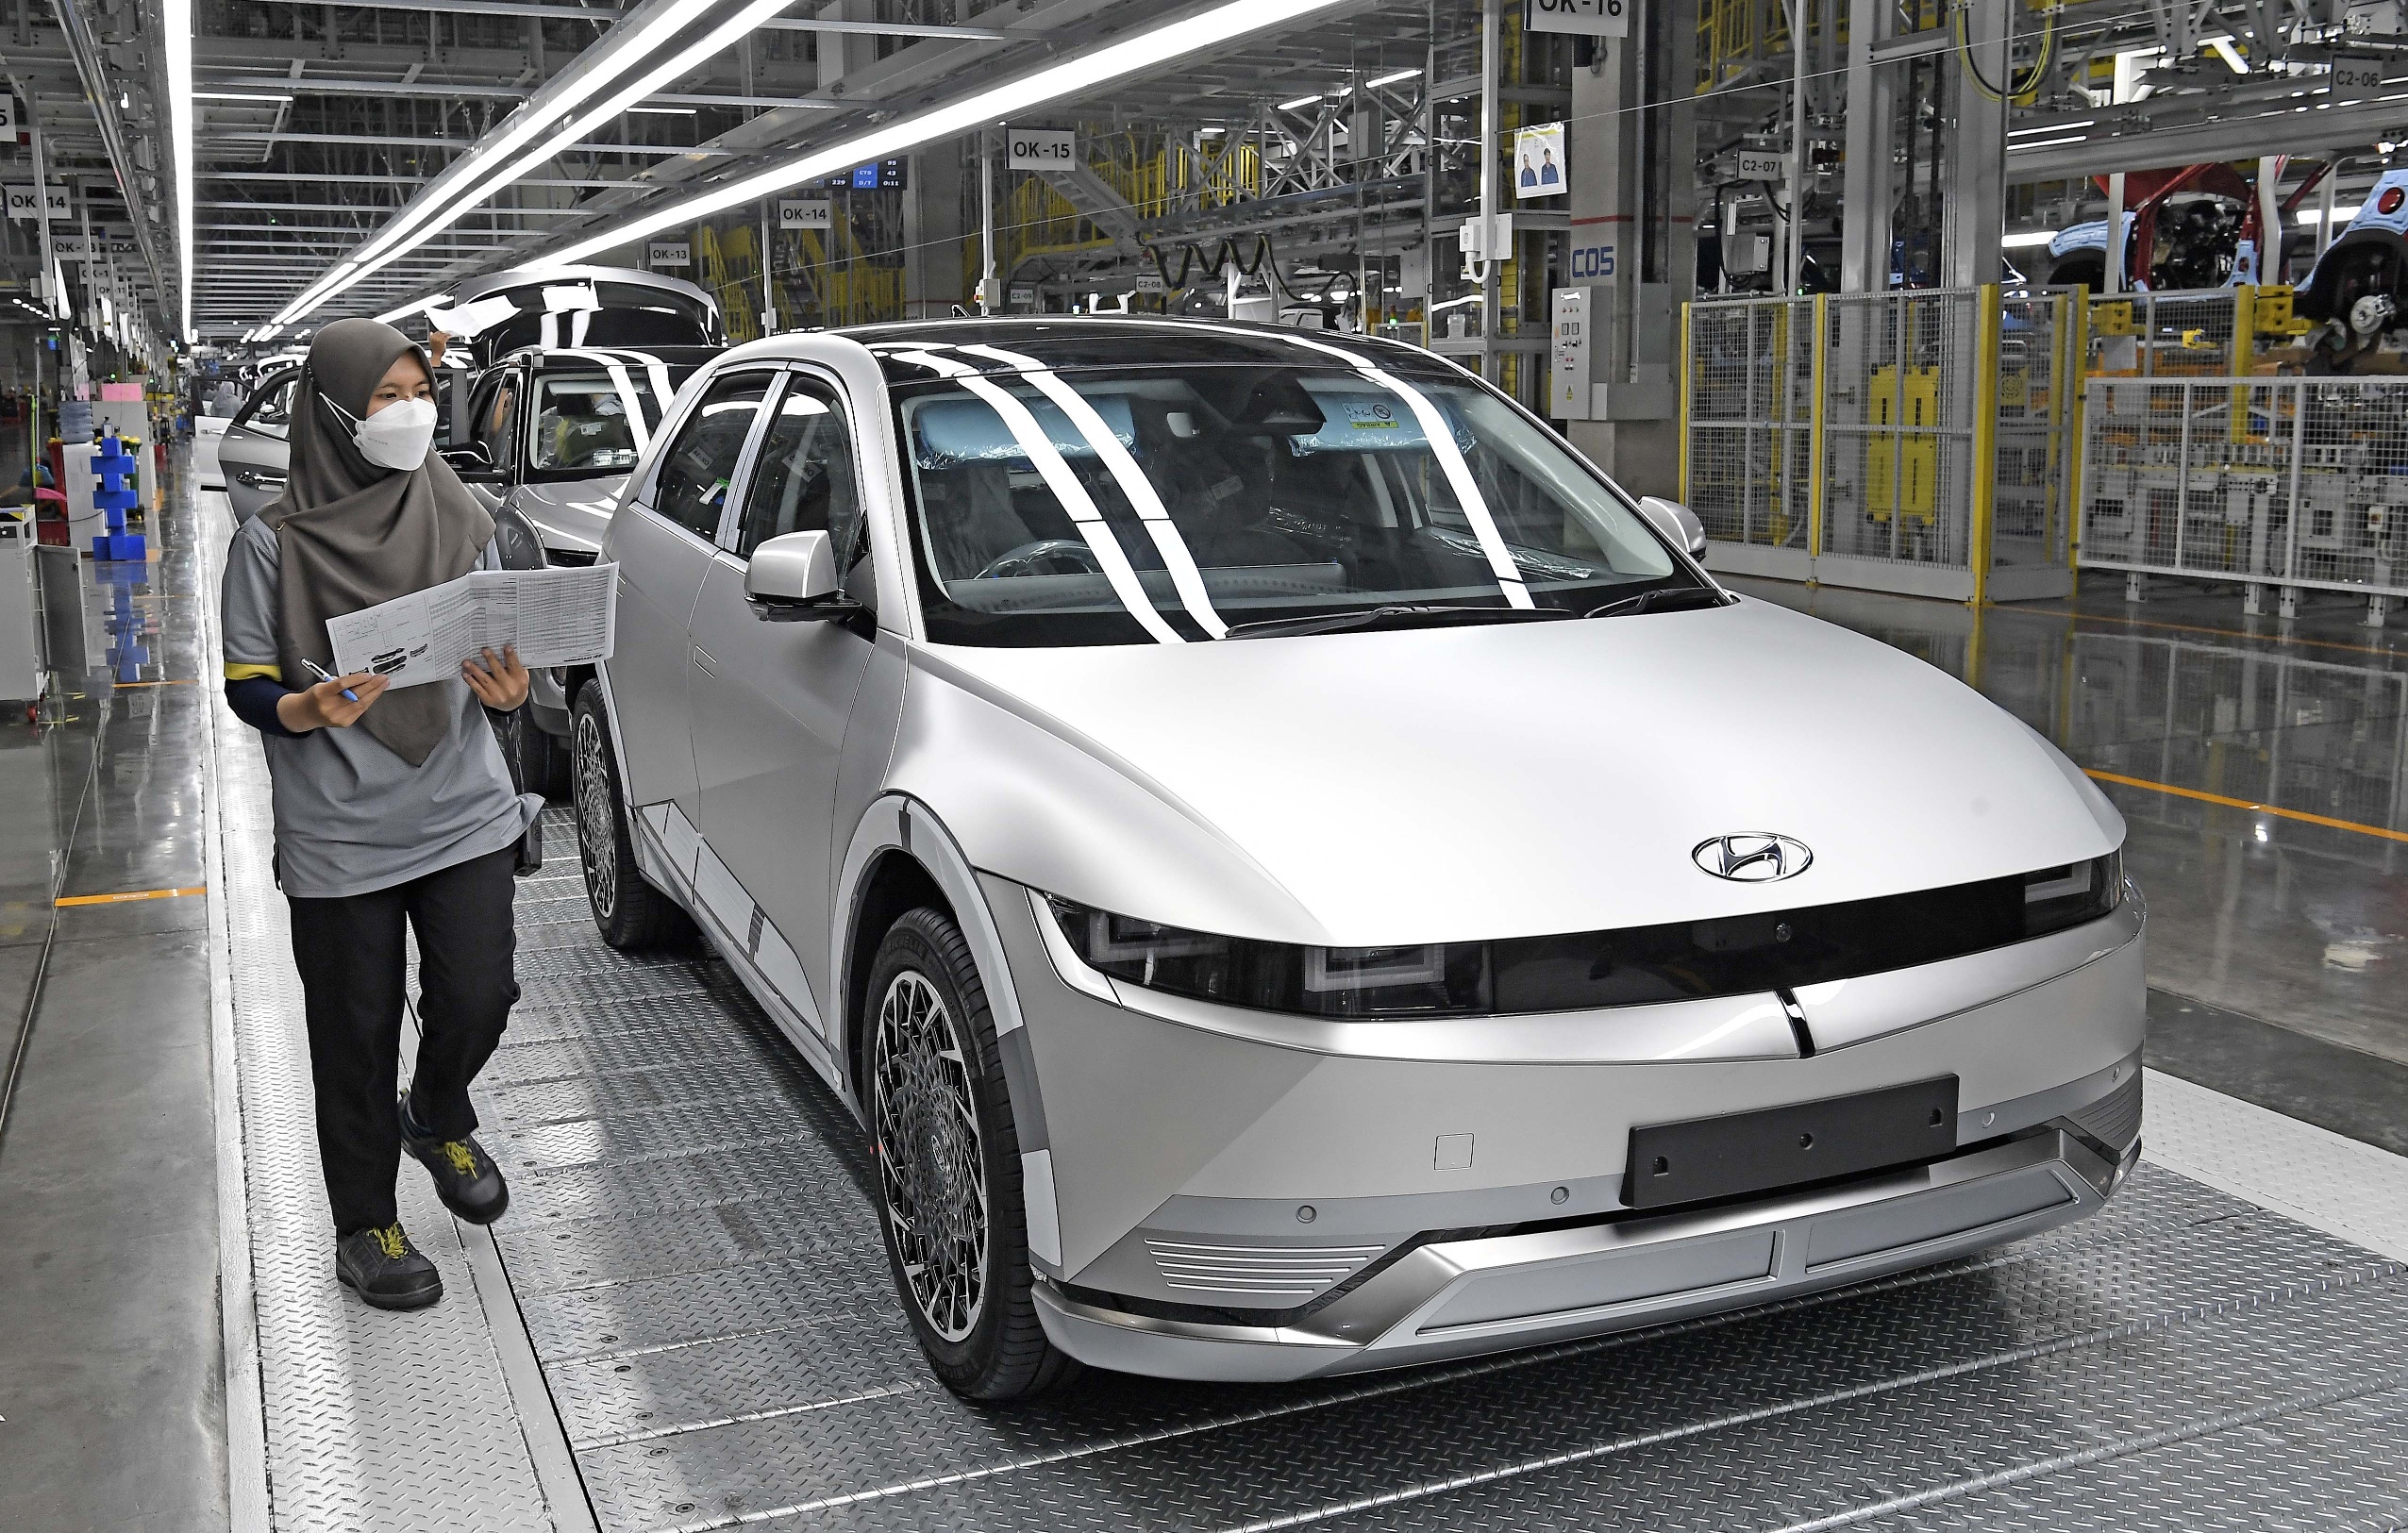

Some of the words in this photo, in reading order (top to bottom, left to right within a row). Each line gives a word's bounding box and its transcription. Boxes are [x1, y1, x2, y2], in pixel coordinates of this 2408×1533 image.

[2335, 70, 2379, 87] C2-06
[1013, 141, 1070, 158] OK-15
[1742, 159, 1776, 172] C2-07
[783, 208, 828, 220] OK-14
[653, 249, 687, 259] OK-13
[1138, 280, 1162, 289] C2-08
